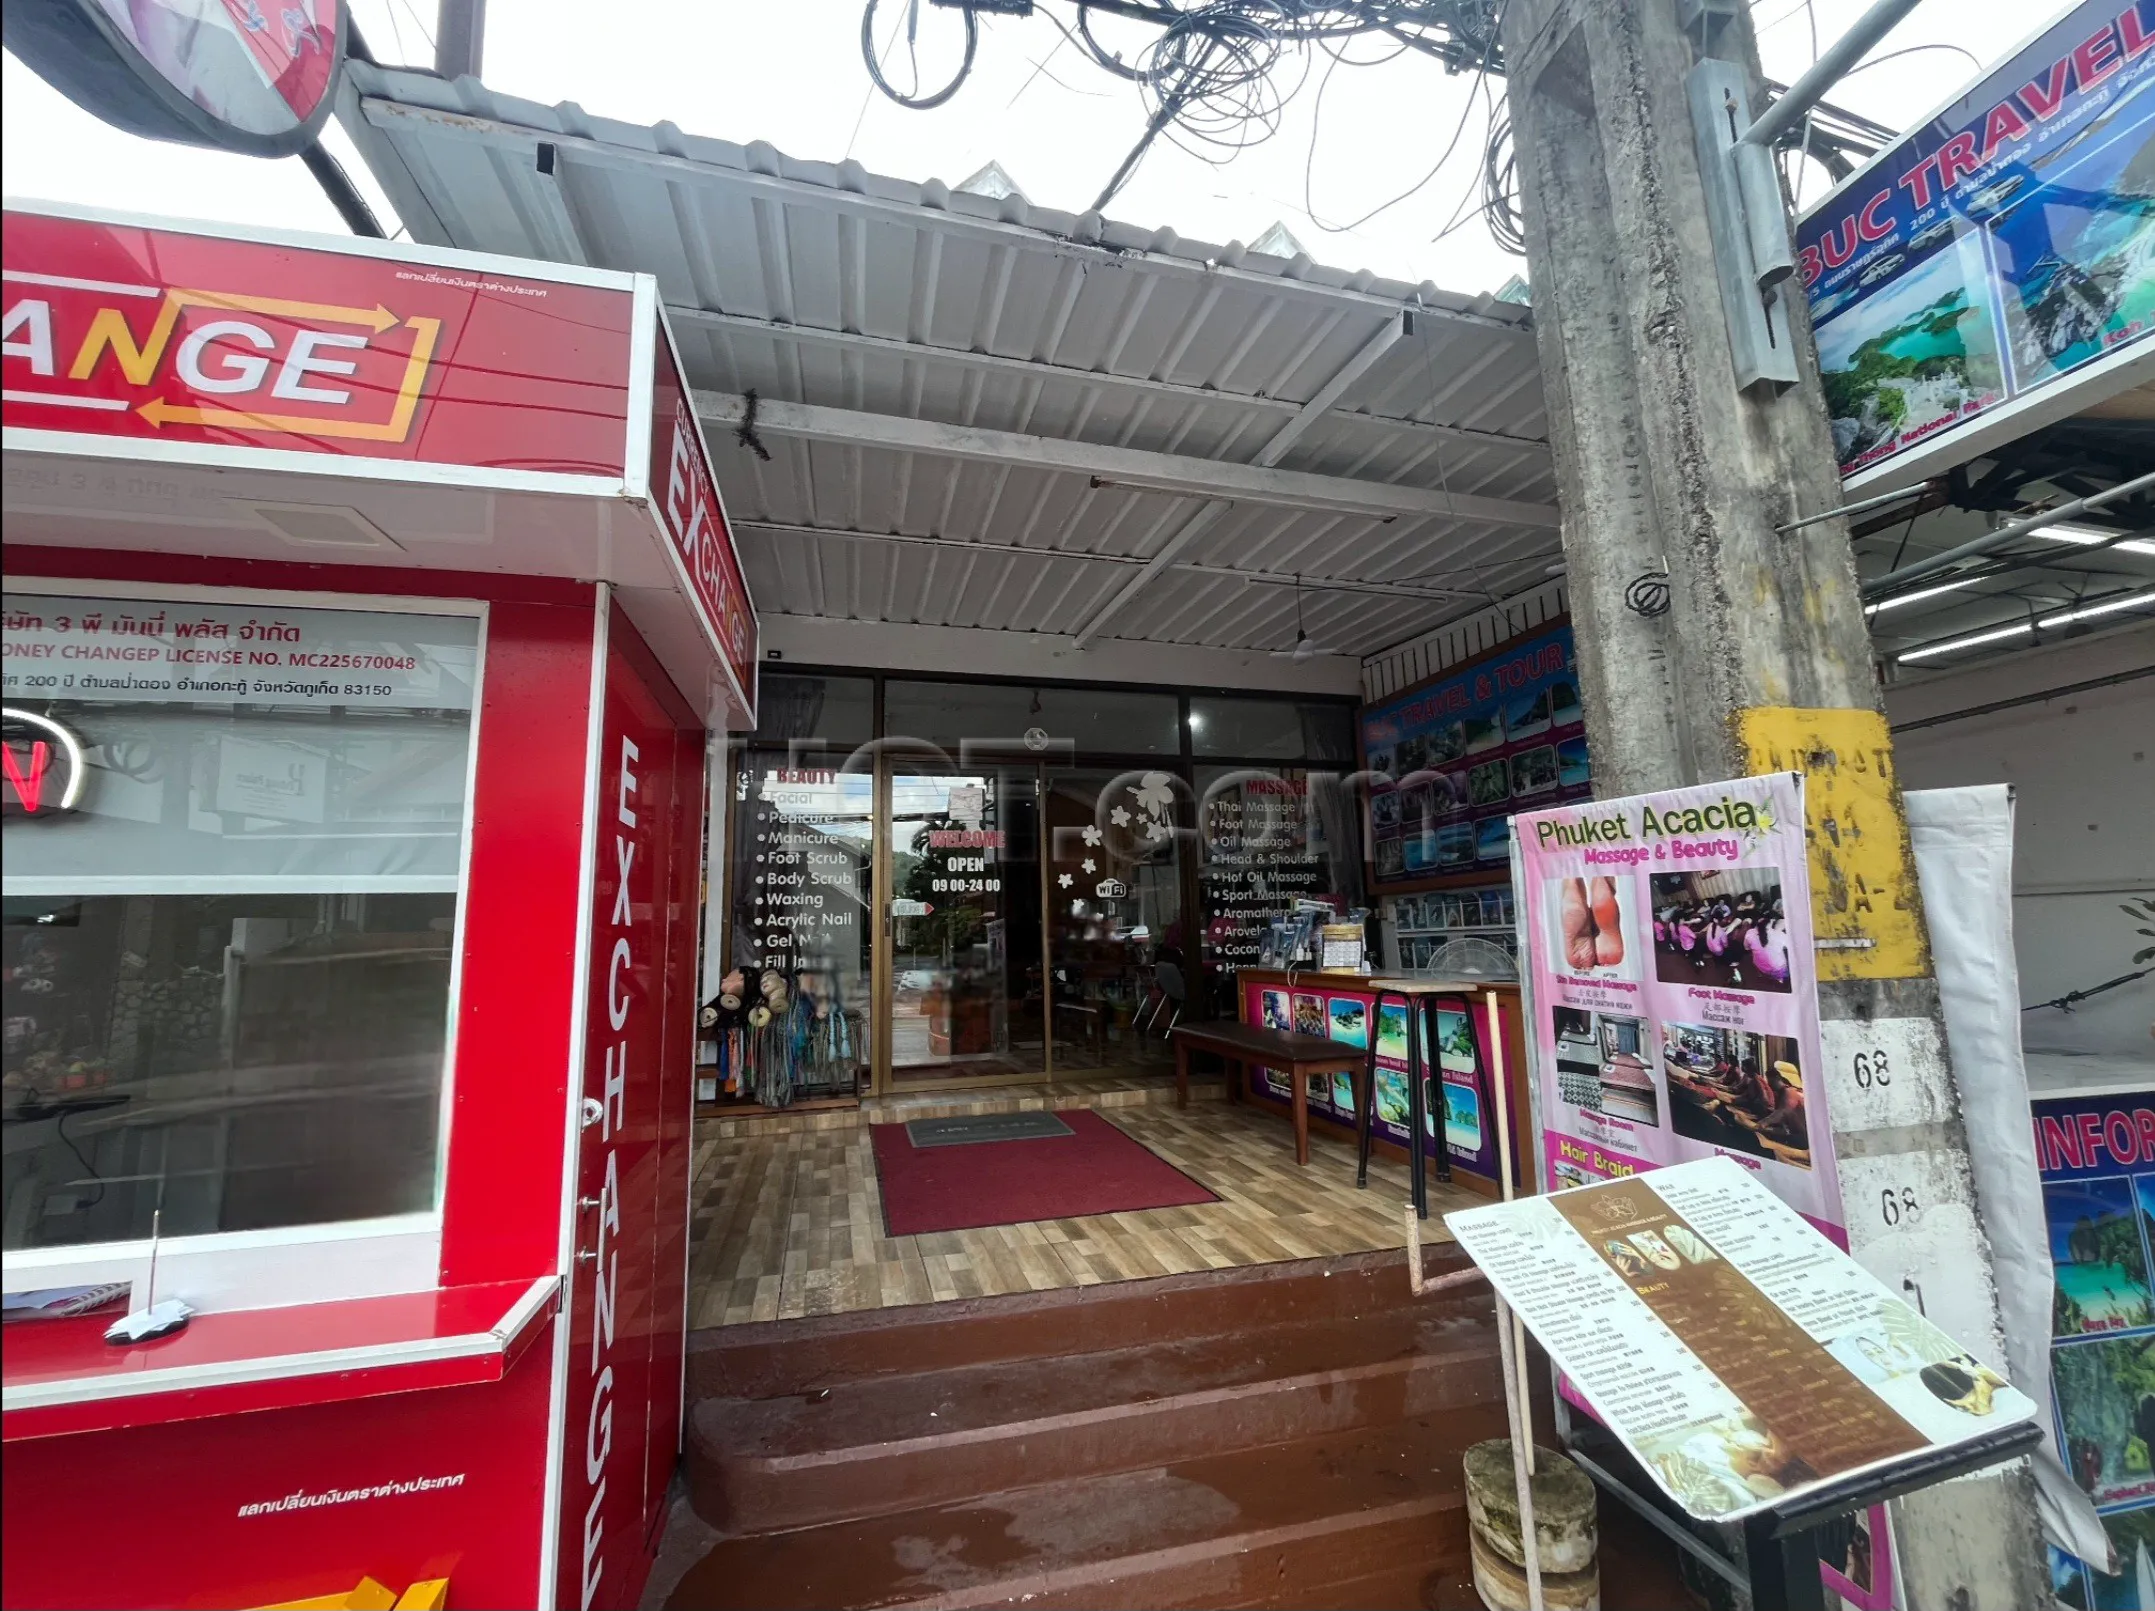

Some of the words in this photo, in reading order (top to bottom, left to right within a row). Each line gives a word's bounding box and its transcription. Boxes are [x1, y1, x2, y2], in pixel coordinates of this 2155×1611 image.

[1898, 8, 2155, 211] TRAVEL
[1910, 207, 1935, 231] 200
[1900, 411, 1957, 444] National
[55, 615, 72, 633] 3
[239, 618, 300, 642] จำกัด
[166, 648, 242, 665] LICENSE
[248, 651, 282, 666] NO.
[289, 653, 416, 671] MC225670048
[25, 675, 57, 687] 200
[344, 683, 392, 696] 83150
[1400, 683, 1472, 729] TRAVEL
[1475, 674, 1492, 702] &
[1494, 642, 1564, 692] TOUR
[777, 768, 836, 784] BEAUTY
[1246, 780, 1308, 795] MASSAGE
[770, 790, 812, 804] Facial
[1218, 801, 1241, 812] Thai
[1246, 801, 1295, 815] Massage
[769, 811, 833, 825] Pedicure
[1219, 818, 1243, 829] Foot
[1248, 818, 1298, 833] Massage
[1536, 813, 1631, 848] Phuket
[1642, 796, 1758, 838] Acacia
[769, 832, 838, 845] Manicure
[929, 830, 1006, 848] WELCOME
[1220, 836, 1236, 847] Oil
[1242, 836, 1291, 851] Massage
[768, 852, 801, 865] Foot
[807, 851, 848, 865] Scrub
[1221, 853, 1253, 865] Head
[1257, 854, 1265, 865] &
[1269, 853, 1319, 865] Shoulder
[1584, 845, 1649, 866] Massage
[1655, 844, 1666, 860] &
[1672, 838, 1738, 861] Beauty
[947, 857, 984, 872] OPEN
[768, 872, 805, 888] Body
[811, 871, 852, 885] Scrub
[1222, 871, 1242, 883] Hot
[1247, 871, 1264, 883] Oil
[1267, 871, 1317, 886] Massage
[767, 893, 823, 908] Waxing
[1222, 890, 1253, 904] Sport
[766, 913, 815, 929] Acrylic
[822, 912, 852, 926] Nail
[767, 934, 792, 948] Gel
[765, 955, 786, 969] Fill
[1688, 987, 1711, 999] Foot
[1854, 1050, 1890, 1088] 68
[2032, 1108, 2155, 1171] INFOR
[1560, 1140, 1588, 1163] Hair
[1594, 1151, 1634, 1177] Braid
[580, 735, 638, 1611] EXCHANGE
[1882, 1187, 1921, 1226] 68
[1635, 1282, 1670, 1295] BEAUTY
[238, 1472, 466, 1518] แลกเปลี่ยนเงินตราต่างประเทศ
